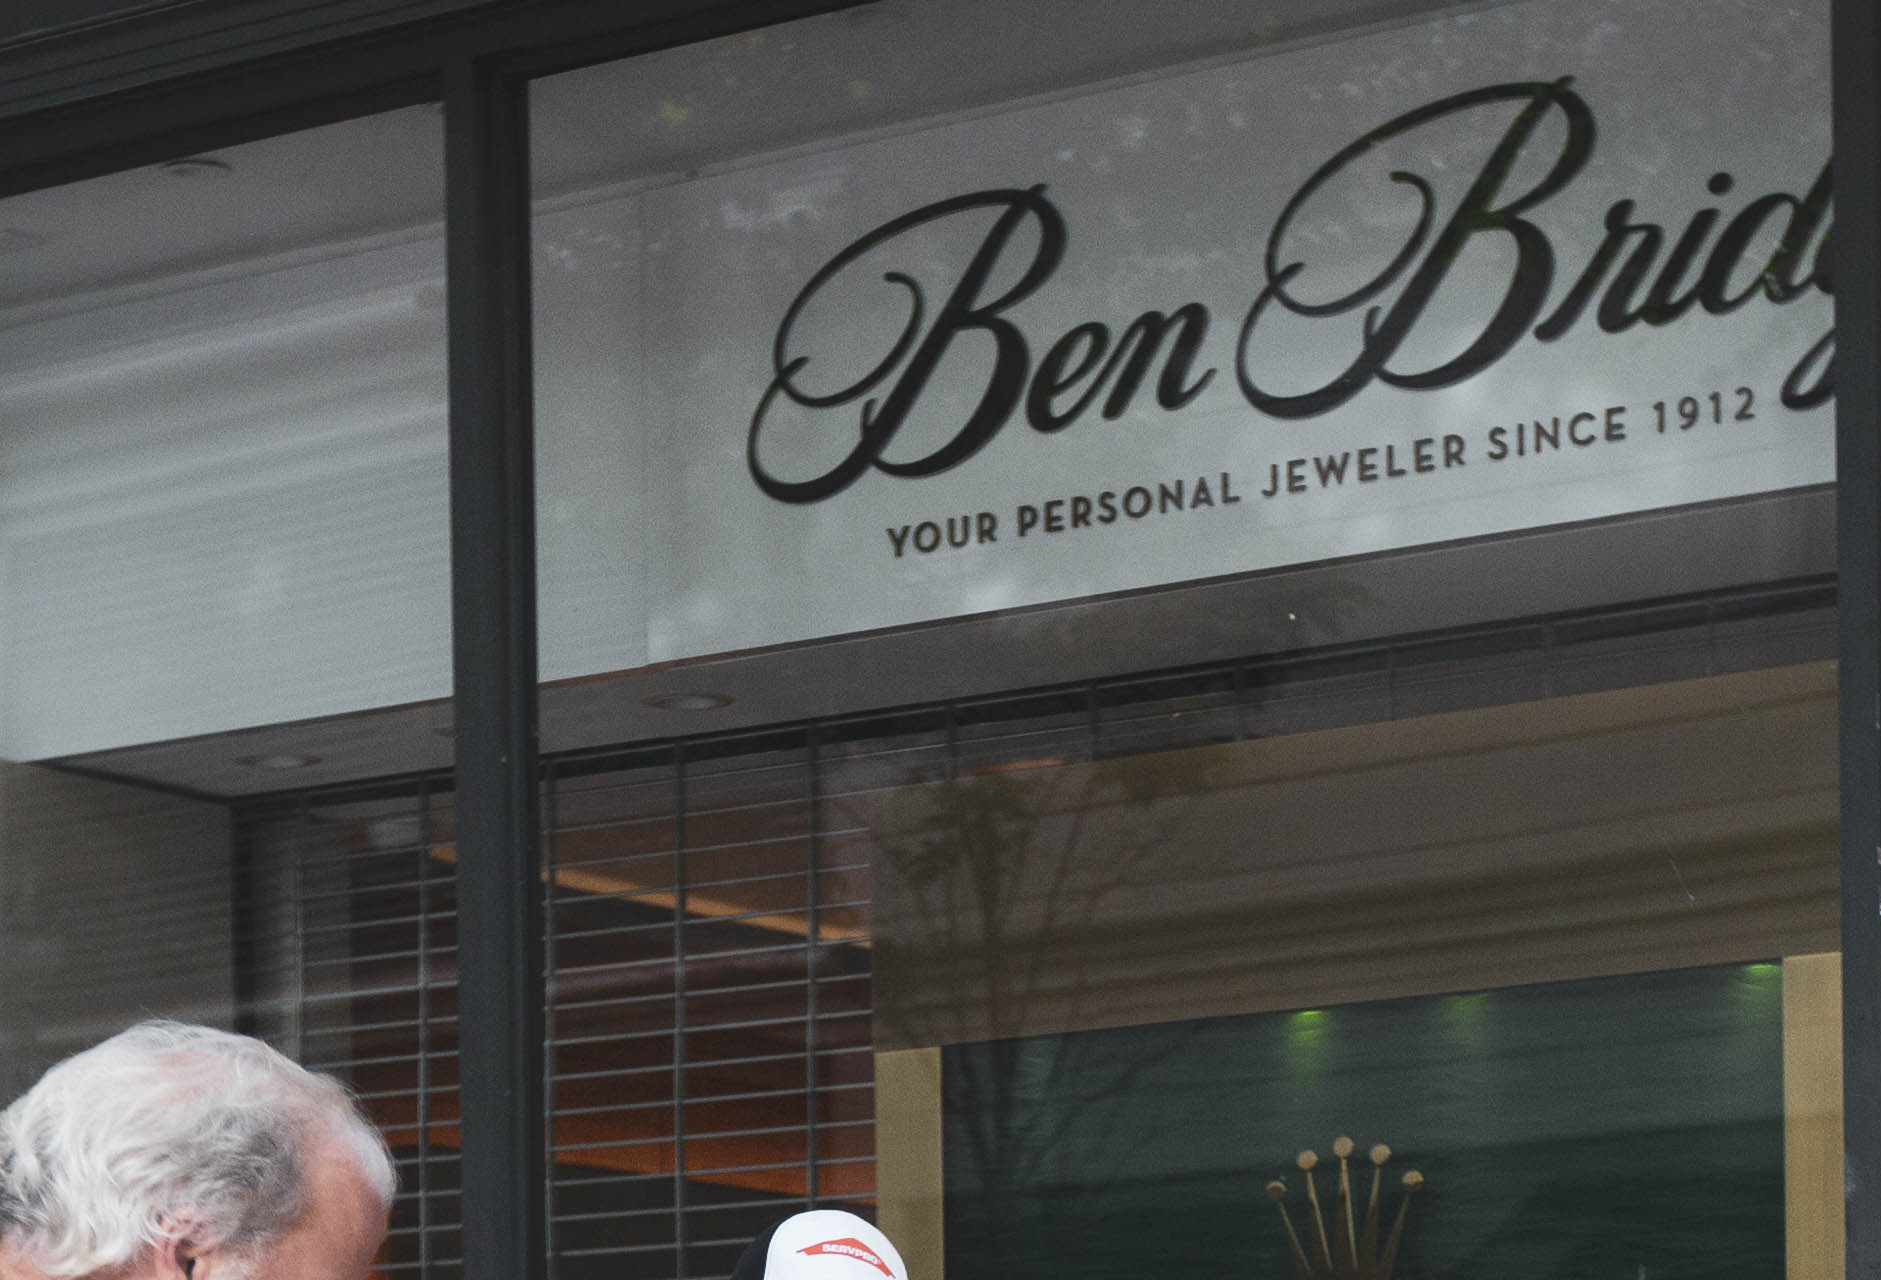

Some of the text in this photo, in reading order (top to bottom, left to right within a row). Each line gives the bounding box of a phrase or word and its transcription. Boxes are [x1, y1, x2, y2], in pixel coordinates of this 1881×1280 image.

[747, 183, 1216, 506] Ben
[886, 386, 1757, 558] YOUR PERSONAL JEWELER SINCE 1912
